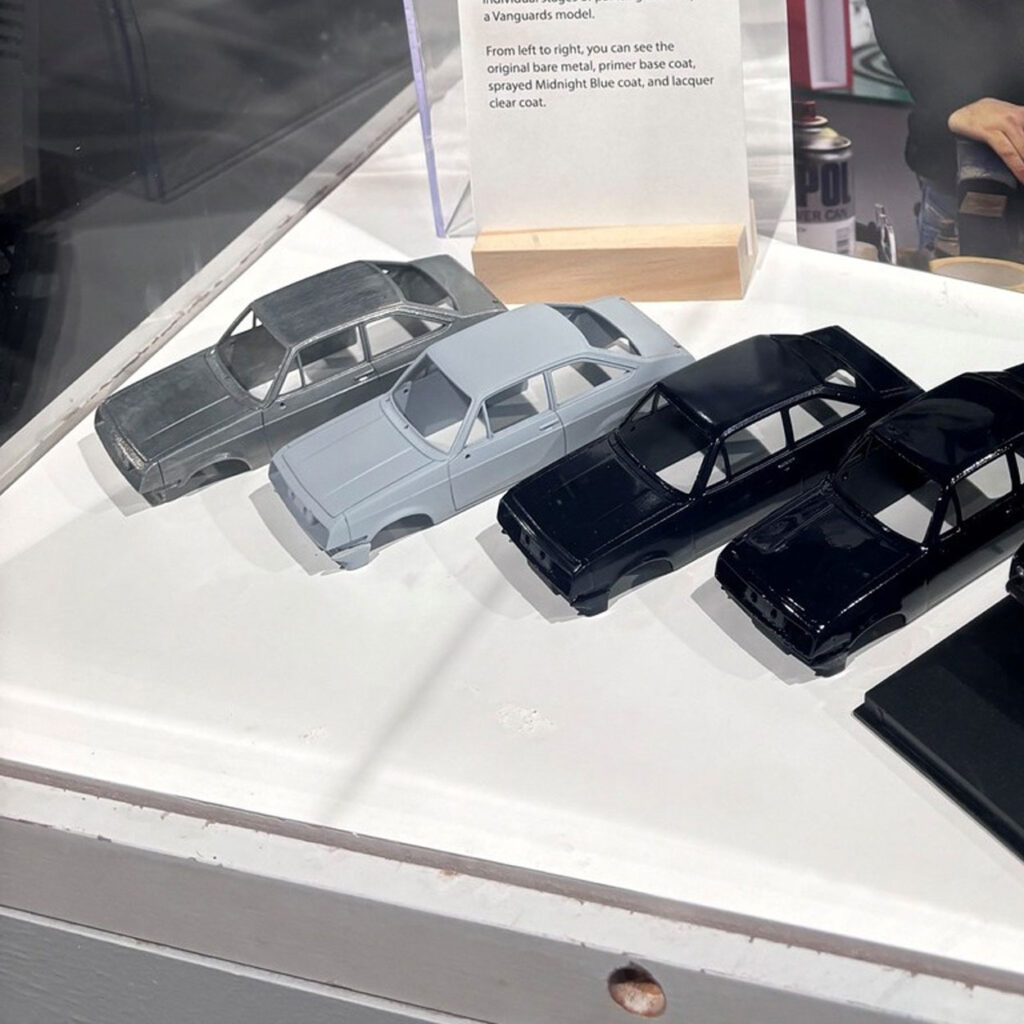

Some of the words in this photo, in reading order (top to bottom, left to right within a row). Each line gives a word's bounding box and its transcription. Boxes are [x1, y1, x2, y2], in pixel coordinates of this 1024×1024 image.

[483, 13, 490, 22] a
[491, 9, 552, 24] Vanguards
[555, 8, 595, 19] model.
[485, 45, 515, 56] From
[517, 43, 536, 55] left
[538, 45, 551, 55] to
[553, 43, 584, 57] right,
[586, 44, 608, 56] you
[610, 44, 631, 53] can
[633, 43, 653, 53] see
[655, 40, 674, 52] the
[486, 61, 530, 76] original
[532, 61, 558, 73] bare
[560, 60, 596, 72] metal,
[598, 60, 636, 73] primer
[638, 58, 666, 70] base
[667, 58, 696, 69] coat,
[488, 79, 532, 93] sprayed
[535, 78, 587, 92] Midnight
[589, 77, 615, 88] Blue
[616, 77, 645, 88] coat,
[647, 75, 669, 87] and
[671, 75, 714, 88] lacquer
[488, 97, 516, 108] clear
[518, 97, 546, 108] coat.
